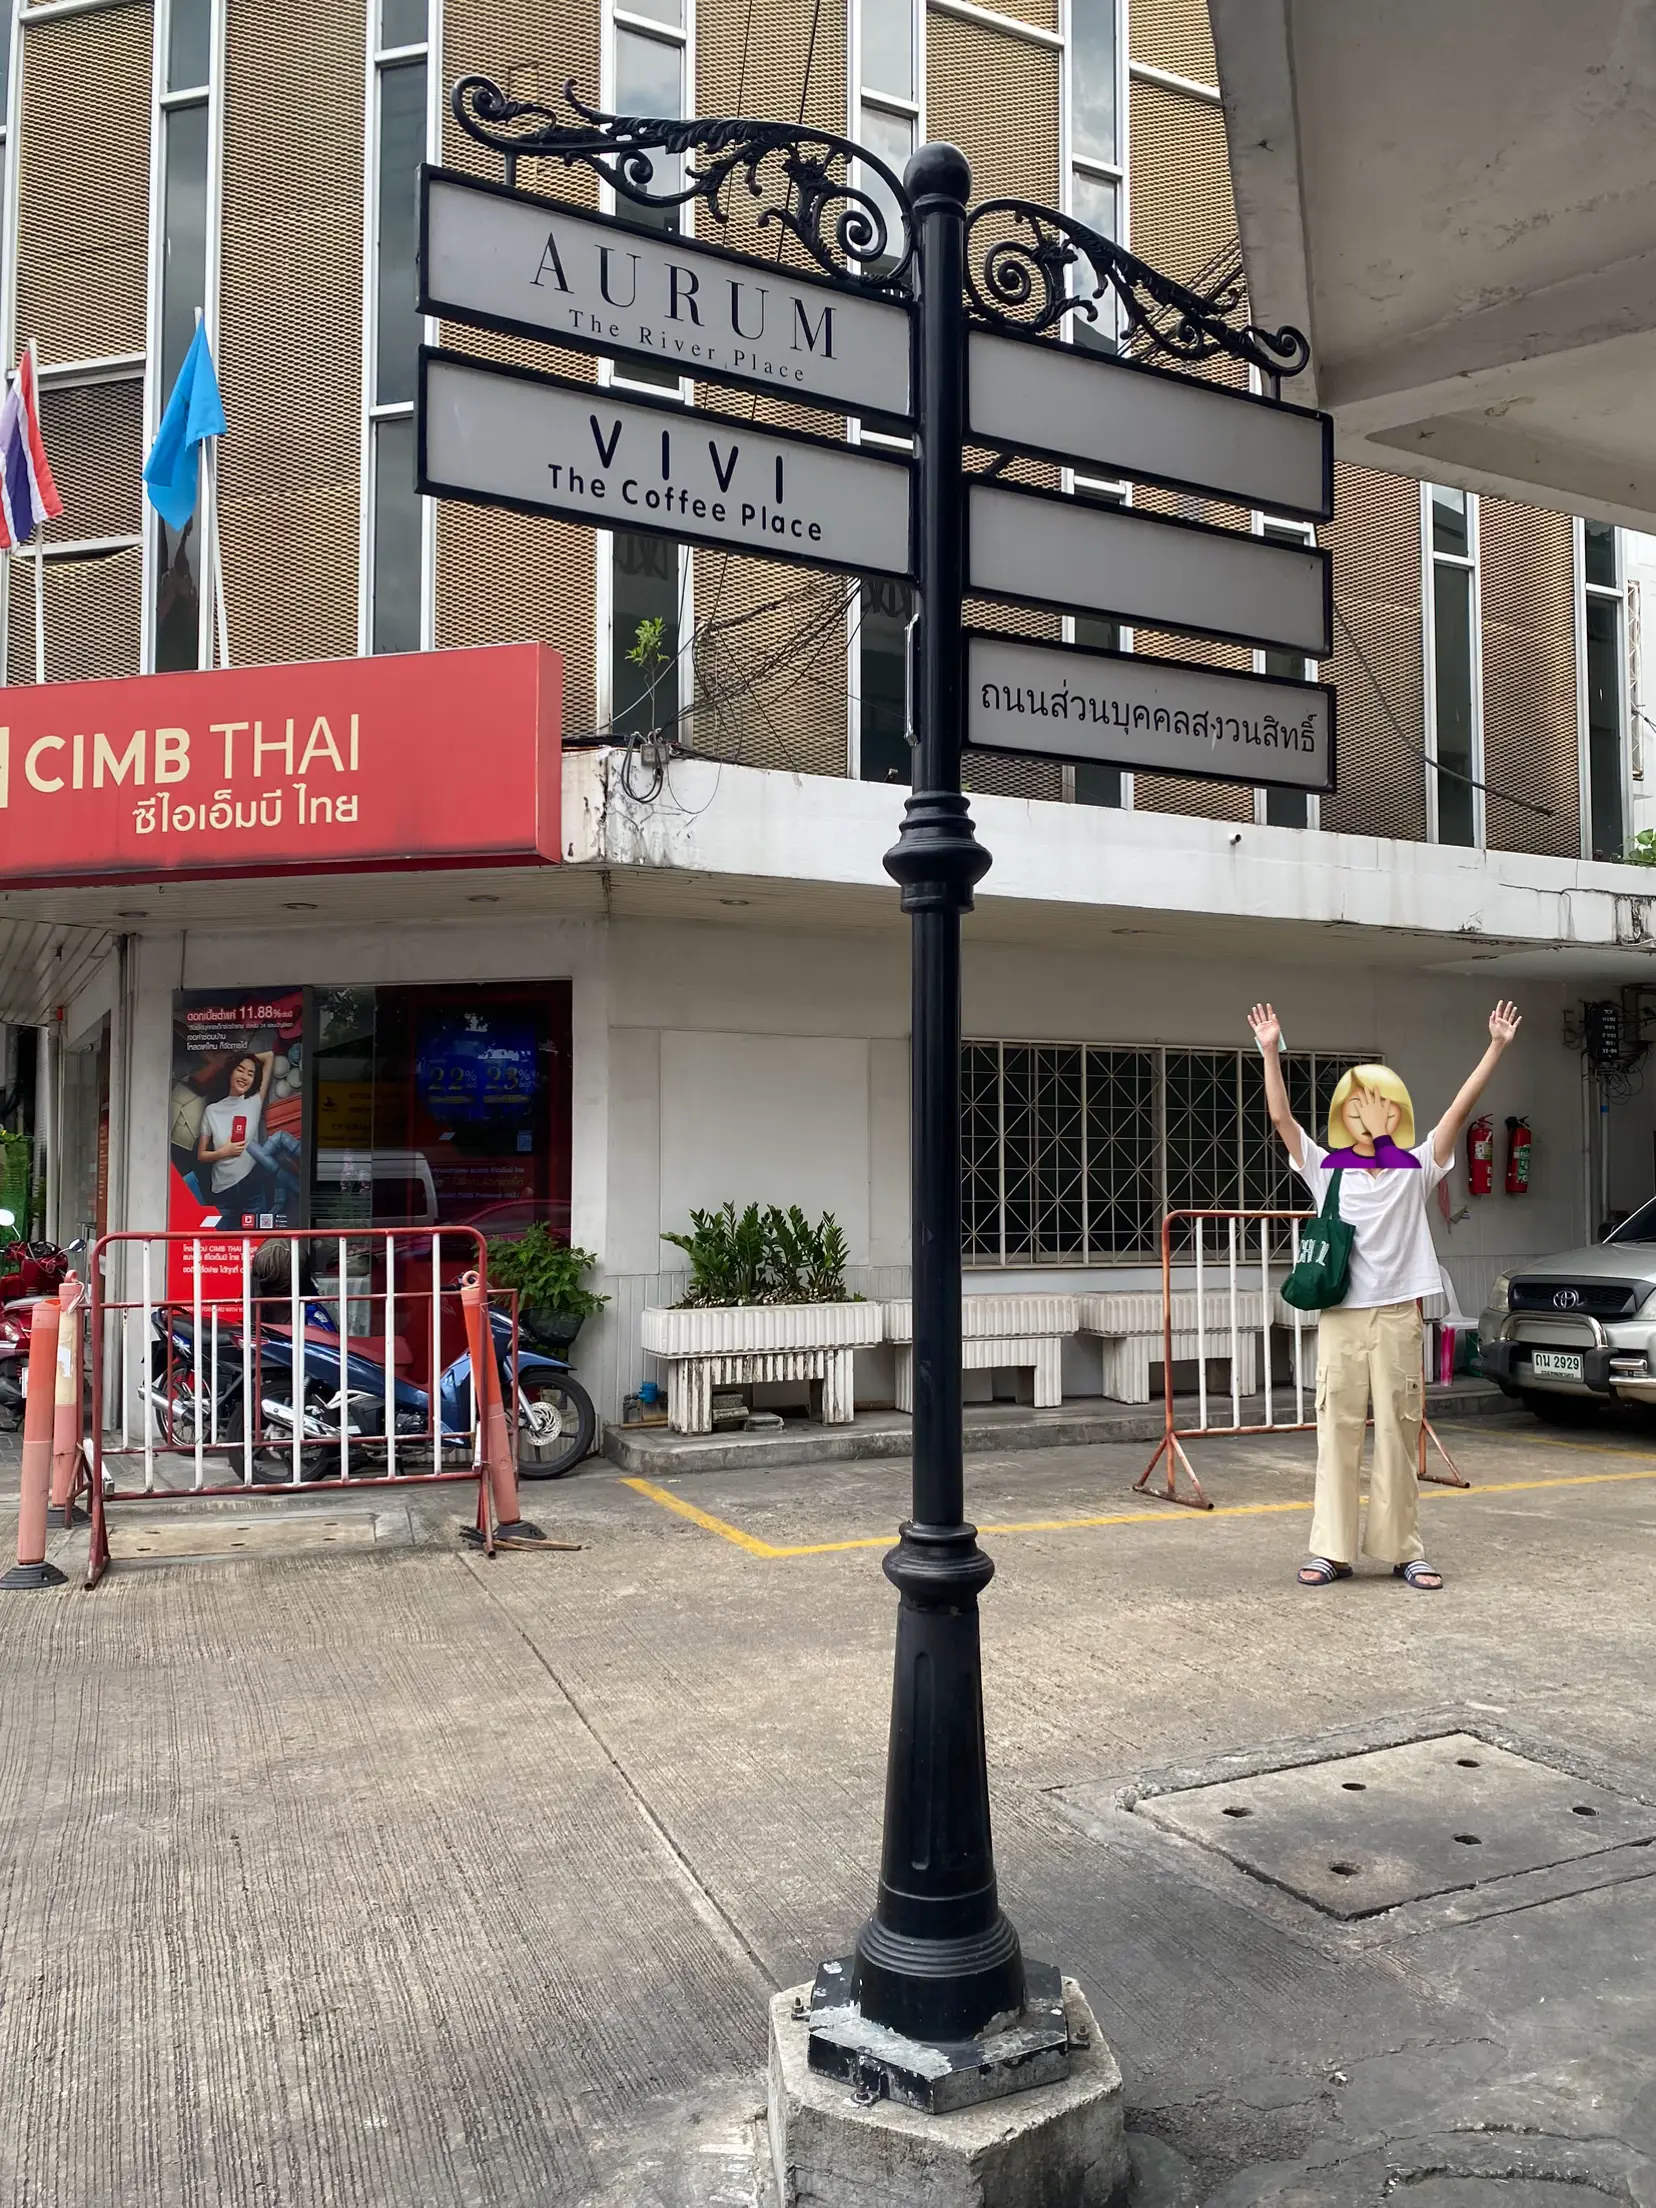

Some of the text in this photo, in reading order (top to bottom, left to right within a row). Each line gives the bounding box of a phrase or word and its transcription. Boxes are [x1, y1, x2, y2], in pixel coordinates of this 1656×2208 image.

[530, 233, 837, 360] AURUM
[568, 308, 806, 382] The River Place
[590, 414, 784, 505] VIVI
[547, 463, 823, 541] The Coffee Place
[24, 713, 359, 793] CIMB THAI
[981, 678, 1318, 753] ถนนส่วนบุคคลสงวนสิทธิ์
[132, 783, 359, 834] ซีไอเอ็มบี ไทย
[1554, 1356, 1579, 1369] 2929
